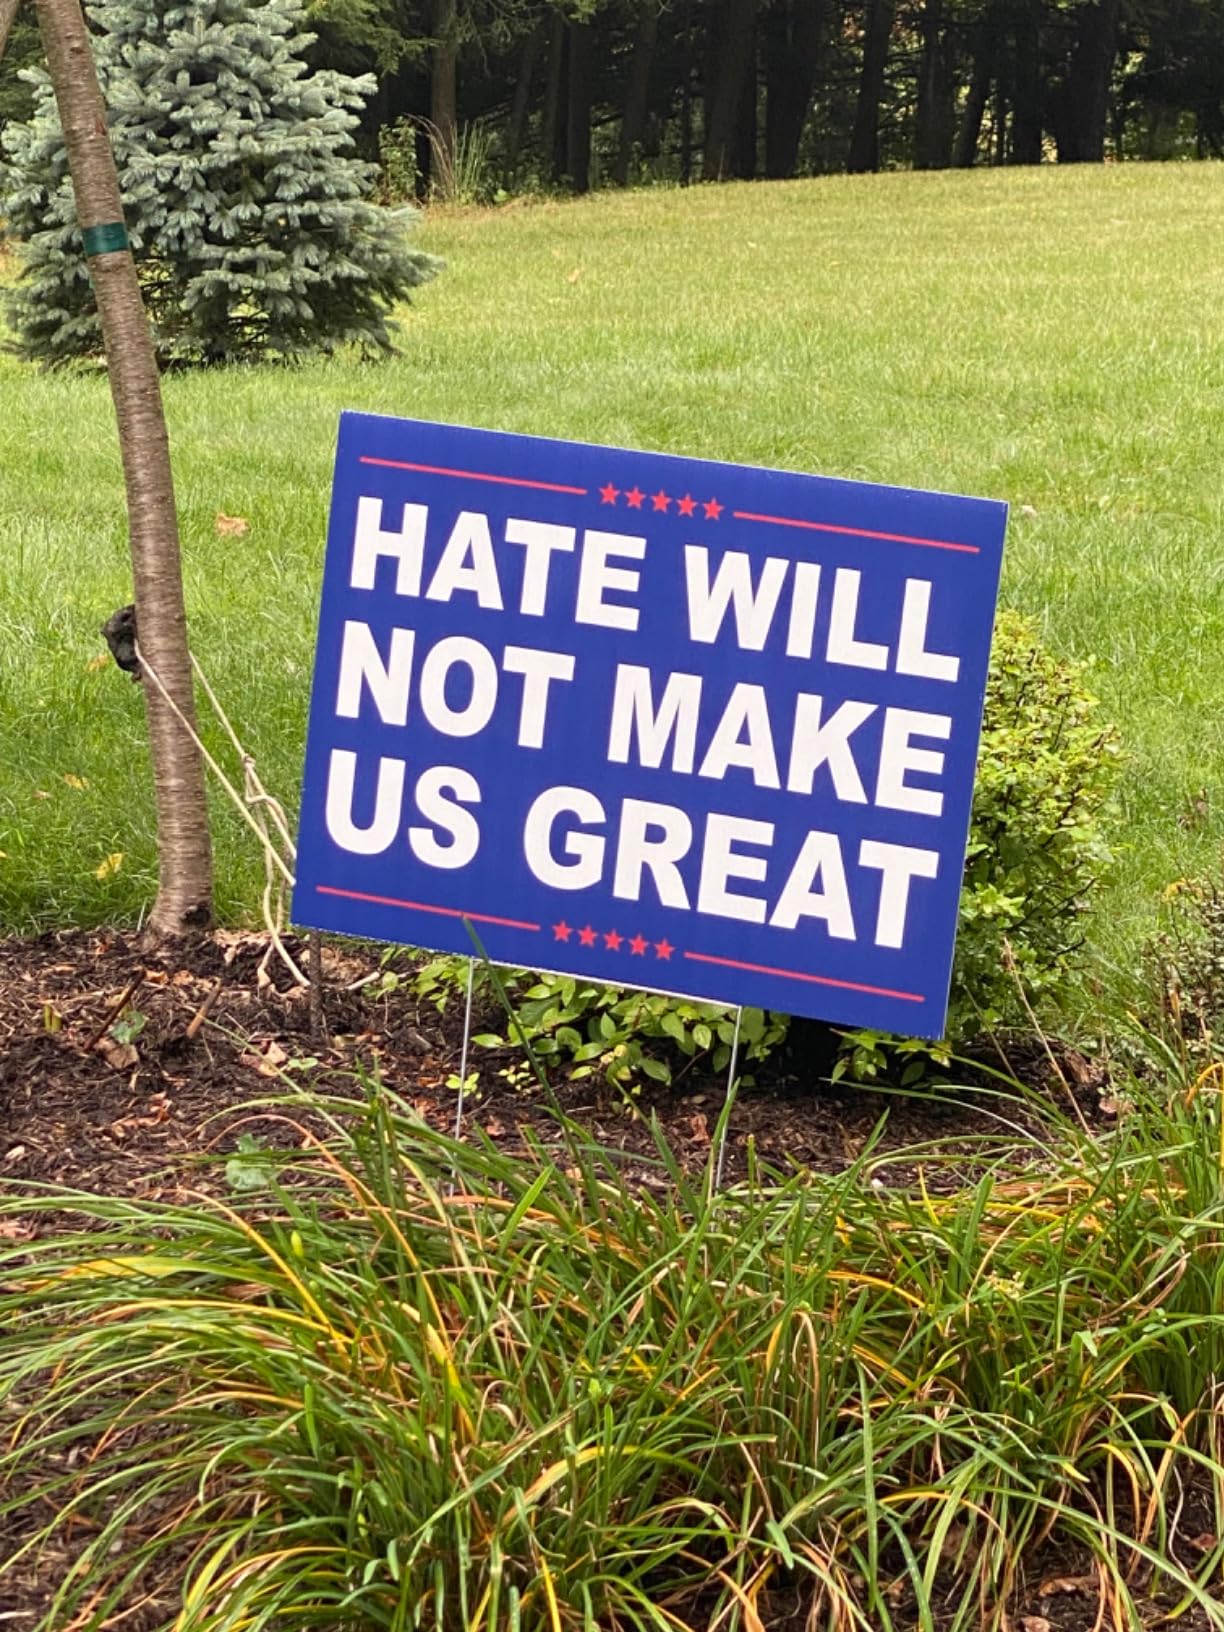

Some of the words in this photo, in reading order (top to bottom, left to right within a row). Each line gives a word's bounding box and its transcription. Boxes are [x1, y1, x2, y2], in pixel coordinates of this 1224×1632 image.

[349, 495, 647, 632] HATE
[684, 544, 961, 683] WILL
[335, 620, 576, 749] NOT
[607, 663, 953, 817] MAKE
[325, 748, 482, 870] US
[523, 785, 940, 949] GREAT
